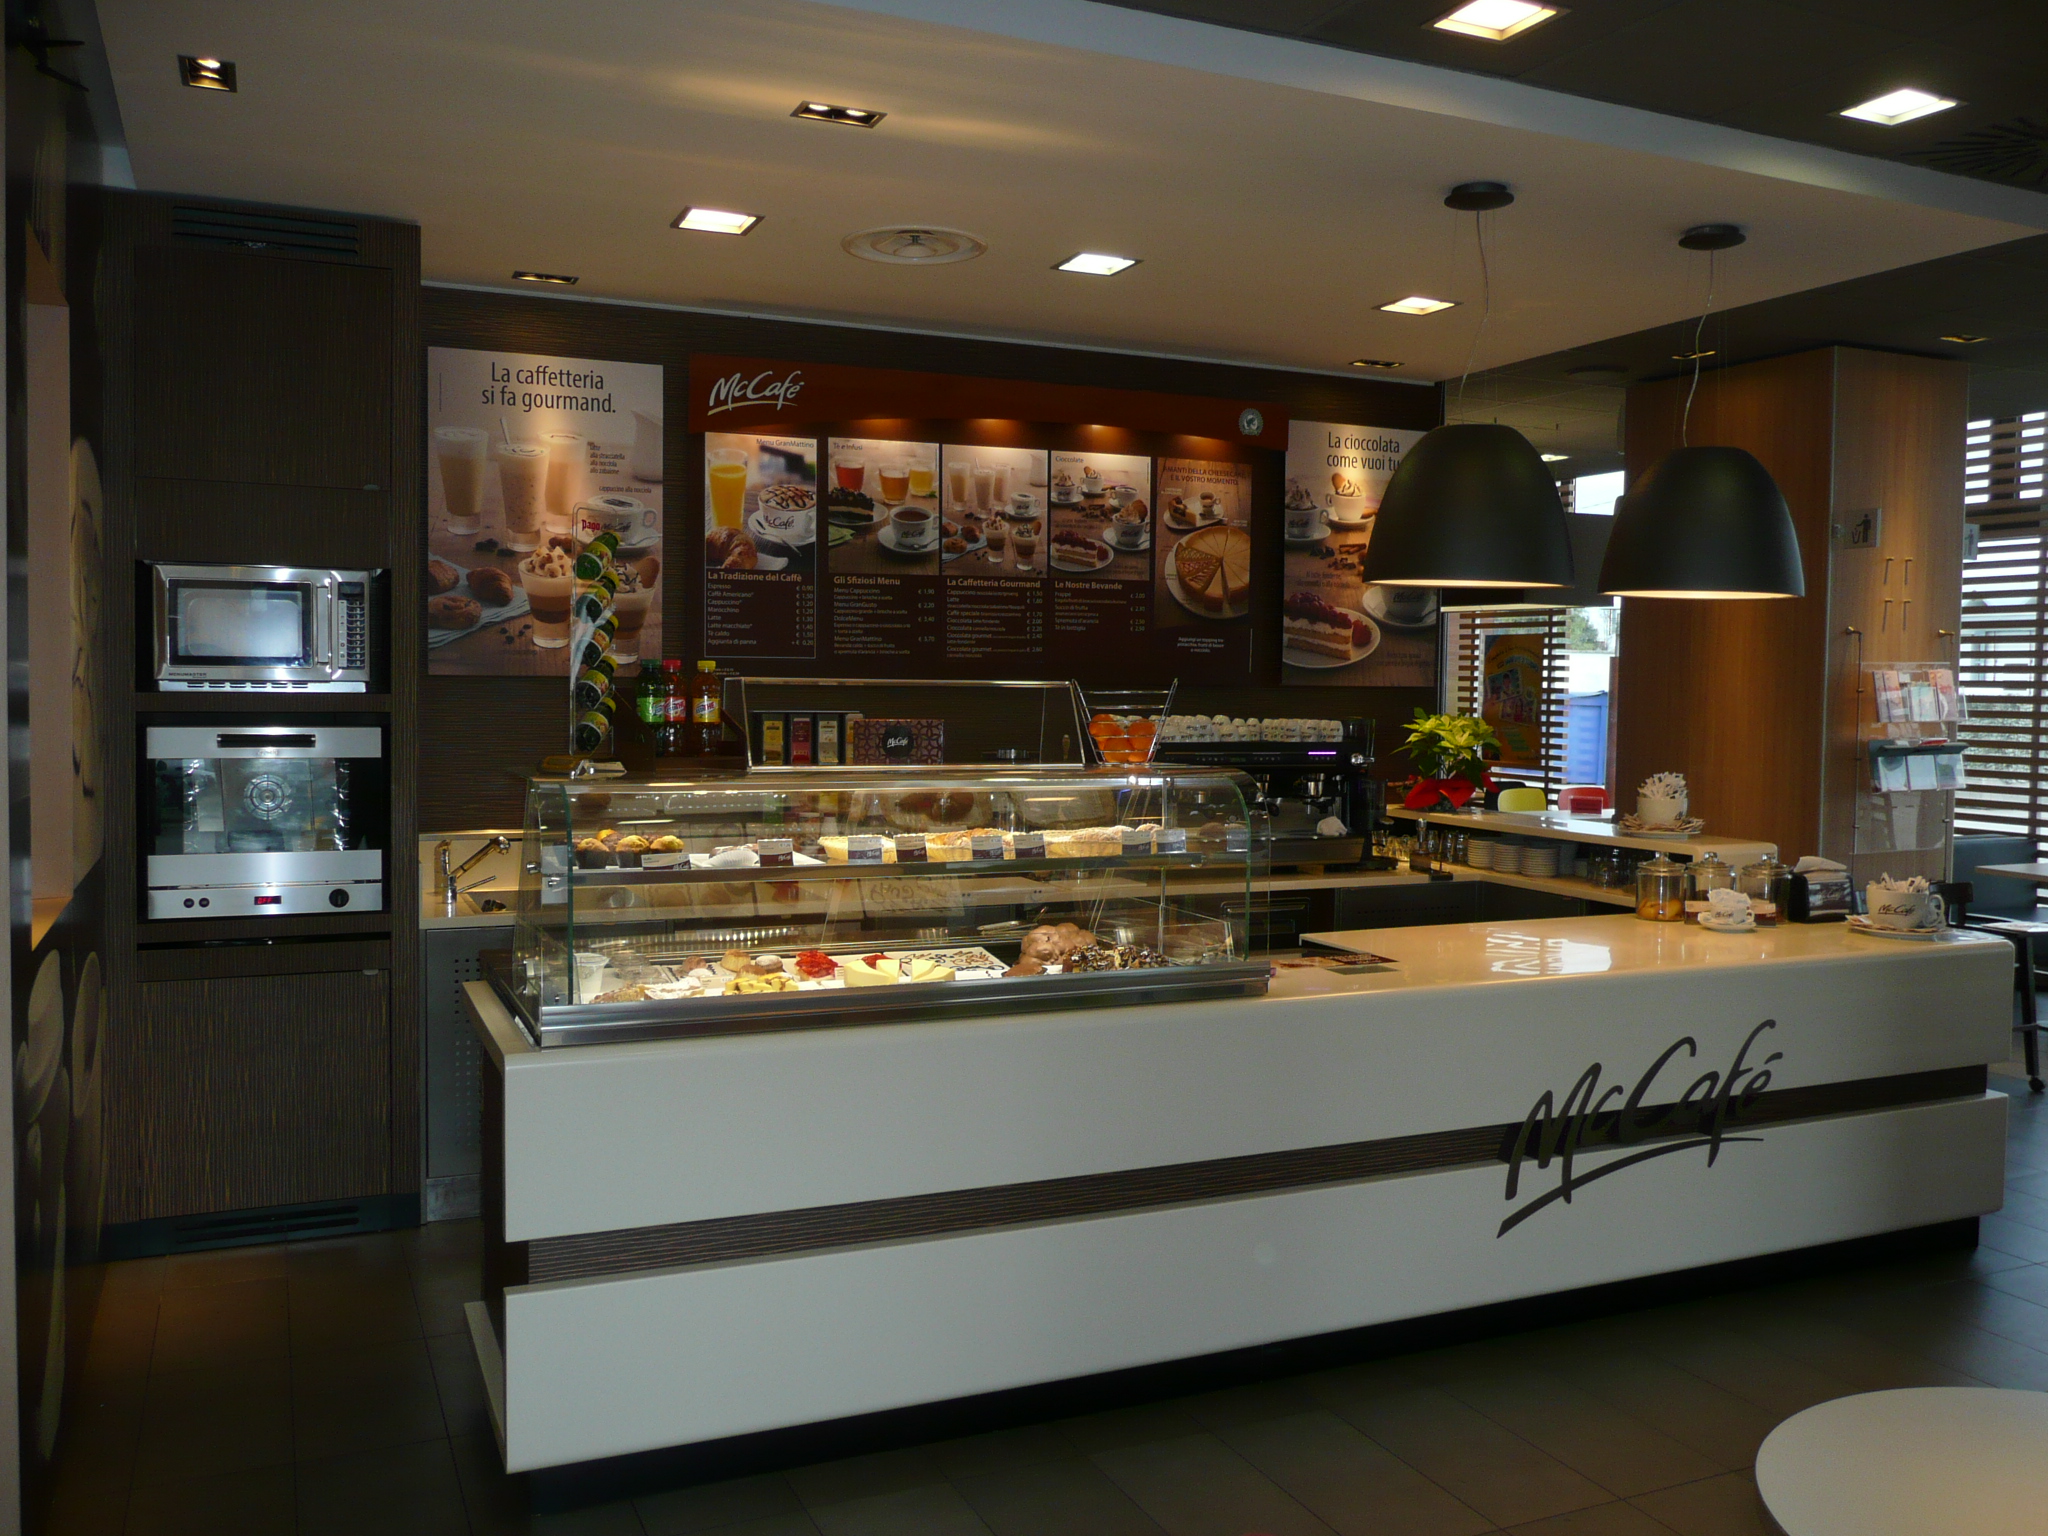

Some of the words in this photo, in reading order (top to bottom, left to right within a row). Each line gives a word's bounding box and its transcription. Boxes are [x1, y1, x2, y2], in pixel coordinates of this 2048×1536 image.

[491, 361, 510, 383] La
[516, 365, 604, 390] caffetteria
[481, 385, 495, 405] si
[500, 385, 516, 406] fa
[522, 393, 616, 413] gourmand.
[708, 370, 805, 413] McCafé
[756, 438, 774, 446] Menu
[1328, 432, 1340, 448] La
[1344, 434, 1400, 453] cioccolata
[1327, 454, 1357, 468] come
[1361, 455, 1385, 471] vuoi
[719, 572, 764, 581] Tradizione
[765, 573, 779, 581] del
[780, 573, 802, 582] Caffè
[834, 576, 845, 584] Gli
[847, 576, 876, 584] Sfiziosi
[877, 577, 900, 585] Menu
[958, 578, 998, 587] Caffetteria
[1000, 580, 1040, 588] Gourmand
[1065, 581, 1090, 589] Nostre
[1091, 582, 1123, 590] Bevande
[1500, 1019, 1784, 1220] McCafé
